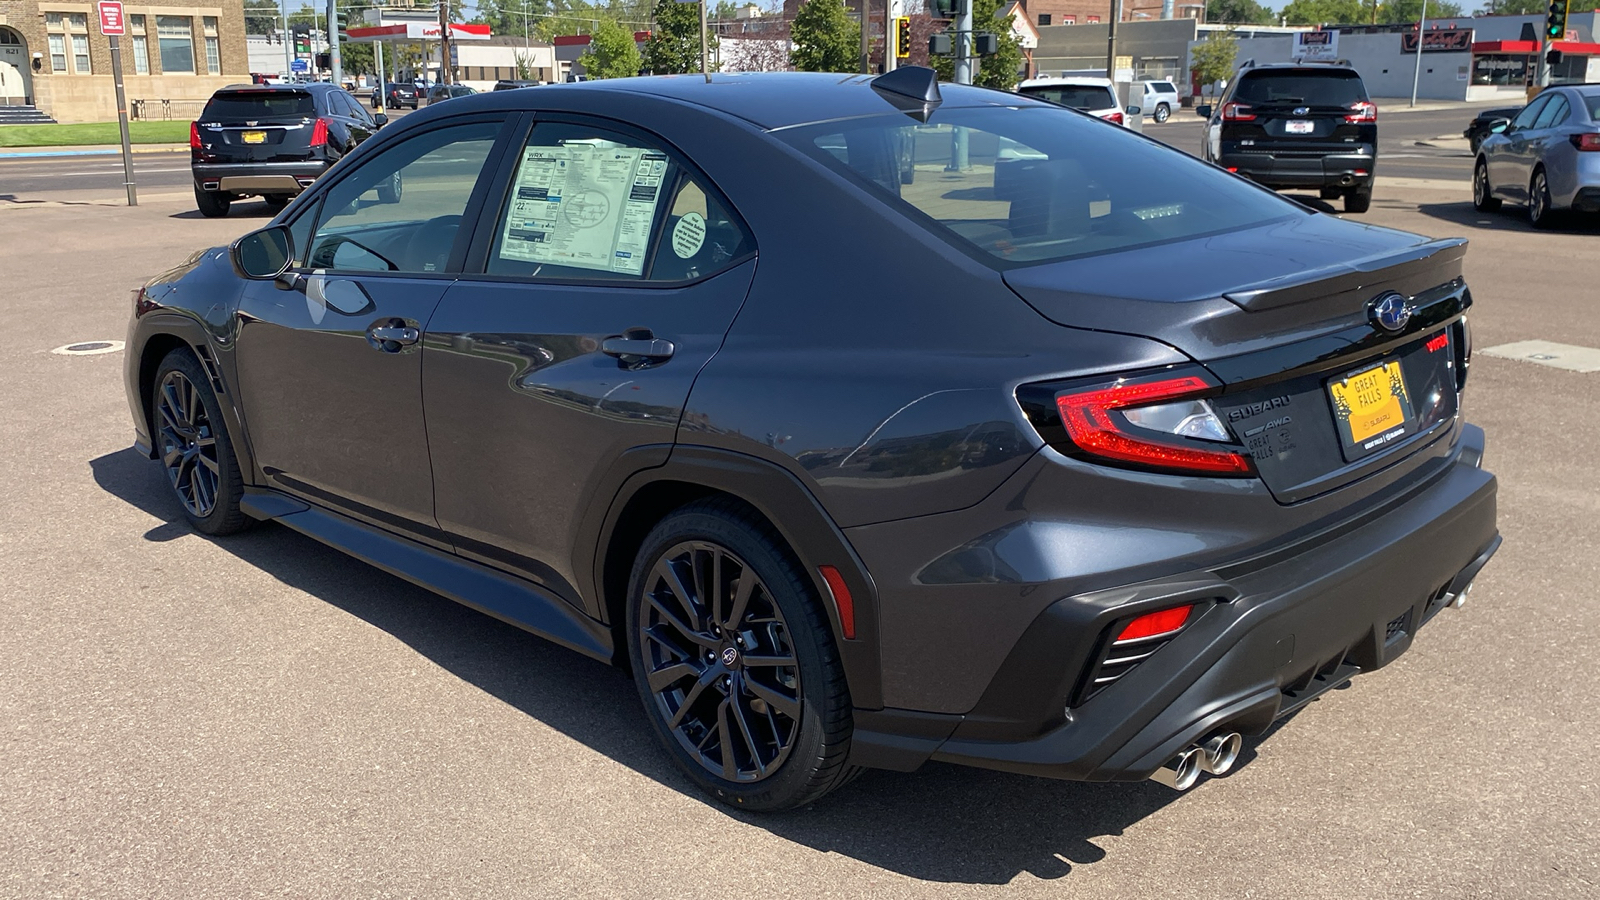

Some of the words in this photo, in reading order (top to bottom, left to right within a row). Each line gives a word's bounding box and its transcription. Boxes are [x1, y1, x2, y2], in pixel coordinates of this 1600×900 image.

[1426, 333, 1449, 354] WRX
[1354, 374, 1379, 394] GREAT
[1358, 388, 1383, 409] FALLS
[1229, 395, 1292, 423] SUBARU
[1264, 416, 1293, 431] AWD
[1370, 413, 1391, 428] SUBARU
[1248, 435, 1271, 450] GREAT
[1251, 446, 1274, 461] FALLS
